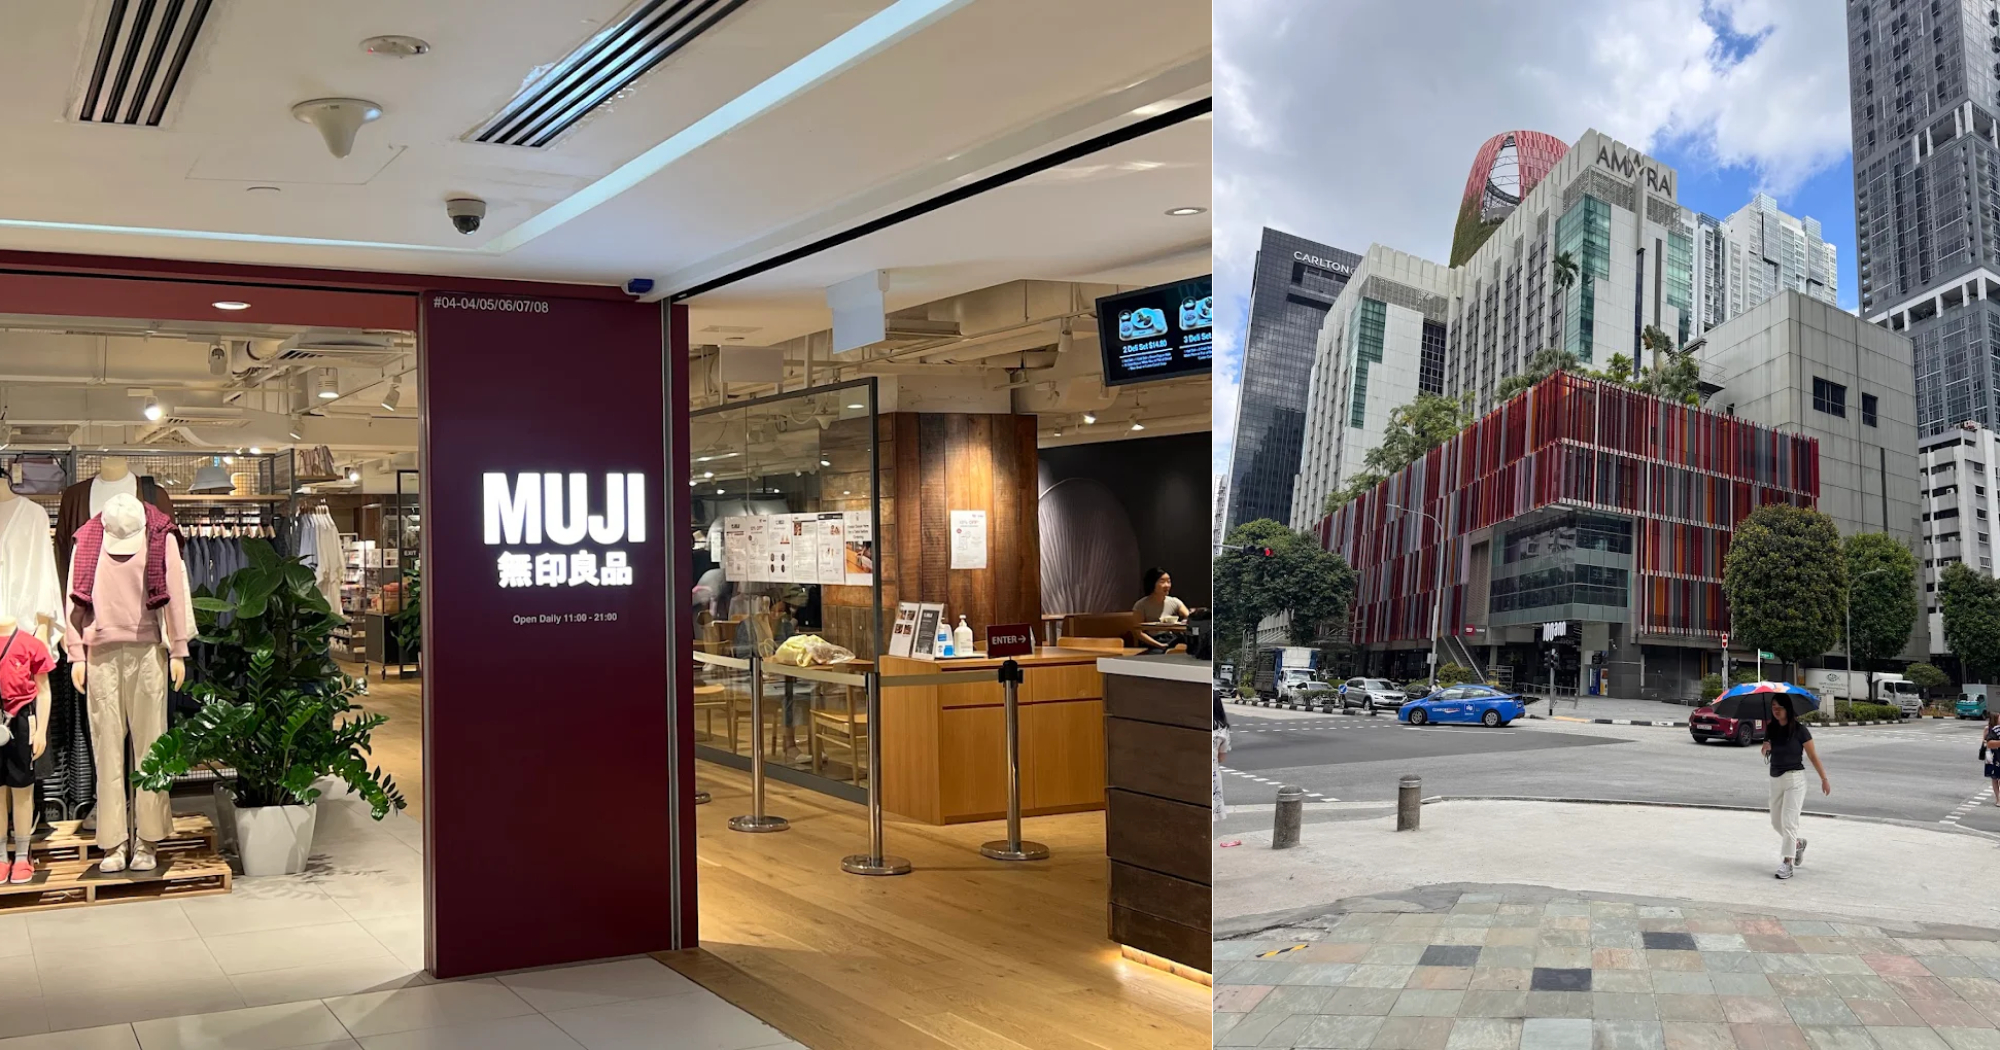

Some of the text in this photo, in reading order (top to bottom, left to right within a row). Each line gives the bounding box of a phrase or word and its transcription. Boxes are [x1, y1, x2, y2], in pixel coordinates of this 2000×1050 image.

[1293, 251, 1350, 274] CARLTON
[433, 296, 549, 314] #04-04/05/06/07/08
[482, 472, 647, 546] MUJI
[497, 550, 634, 588] 無印良品
[512, 614, 537, 625] Open
[539, 614, 561, 625] Daily
[563, 613, 587, 622] 11:00
[593, 612, 617, 621] 21:00
[991, 635, 1018, 645] ENTER
